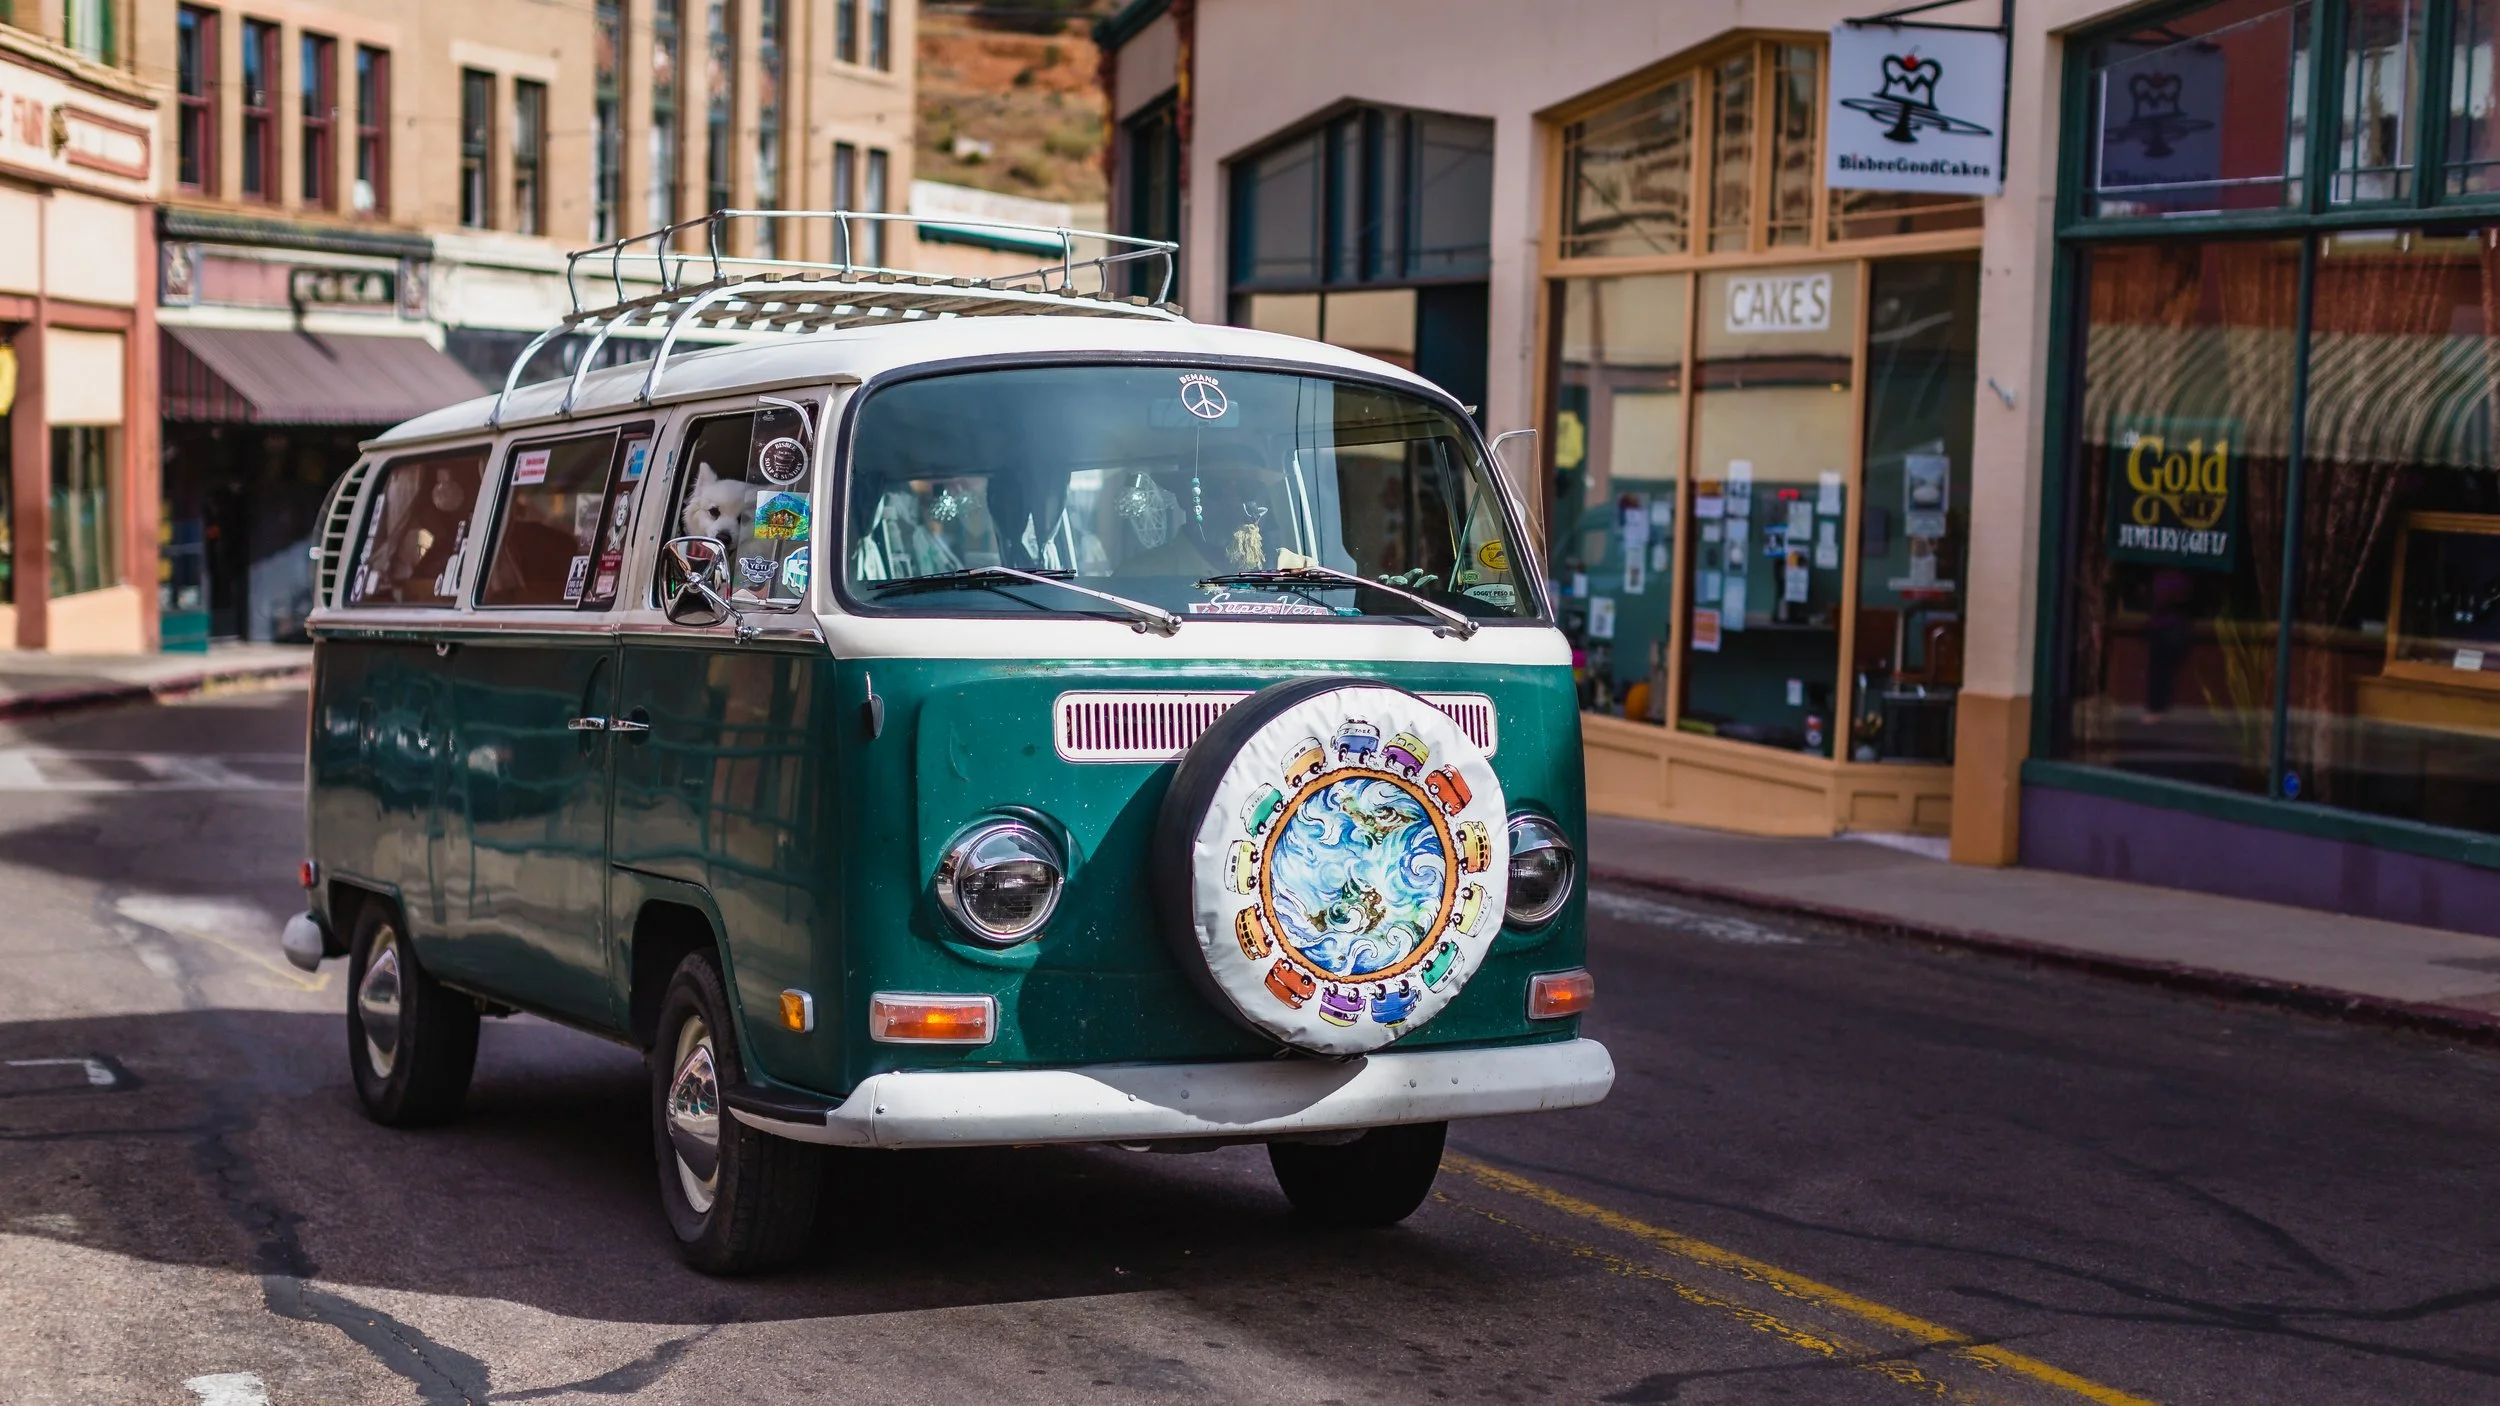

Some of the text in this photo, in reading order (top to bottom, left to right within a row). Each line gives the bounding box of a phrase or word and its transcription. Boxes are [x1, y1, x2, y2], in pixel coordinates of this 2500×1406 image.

[1838, 154, 1990, 177] BisbeeGoodCakes
[1731, 279, 1827, 326] CAKES
[1179, 373, 1219, 386] DEMAND
[774, 441, 797, 452] BISBEE
[764, 457, 775, 474] SOAP
[780, 462, 803, 480] SUNDRY
[2127, 434, 2229, 495] Gold
[750, 562, 768, 570] YETI
[1202, 592, 1325, 616] Super Van
